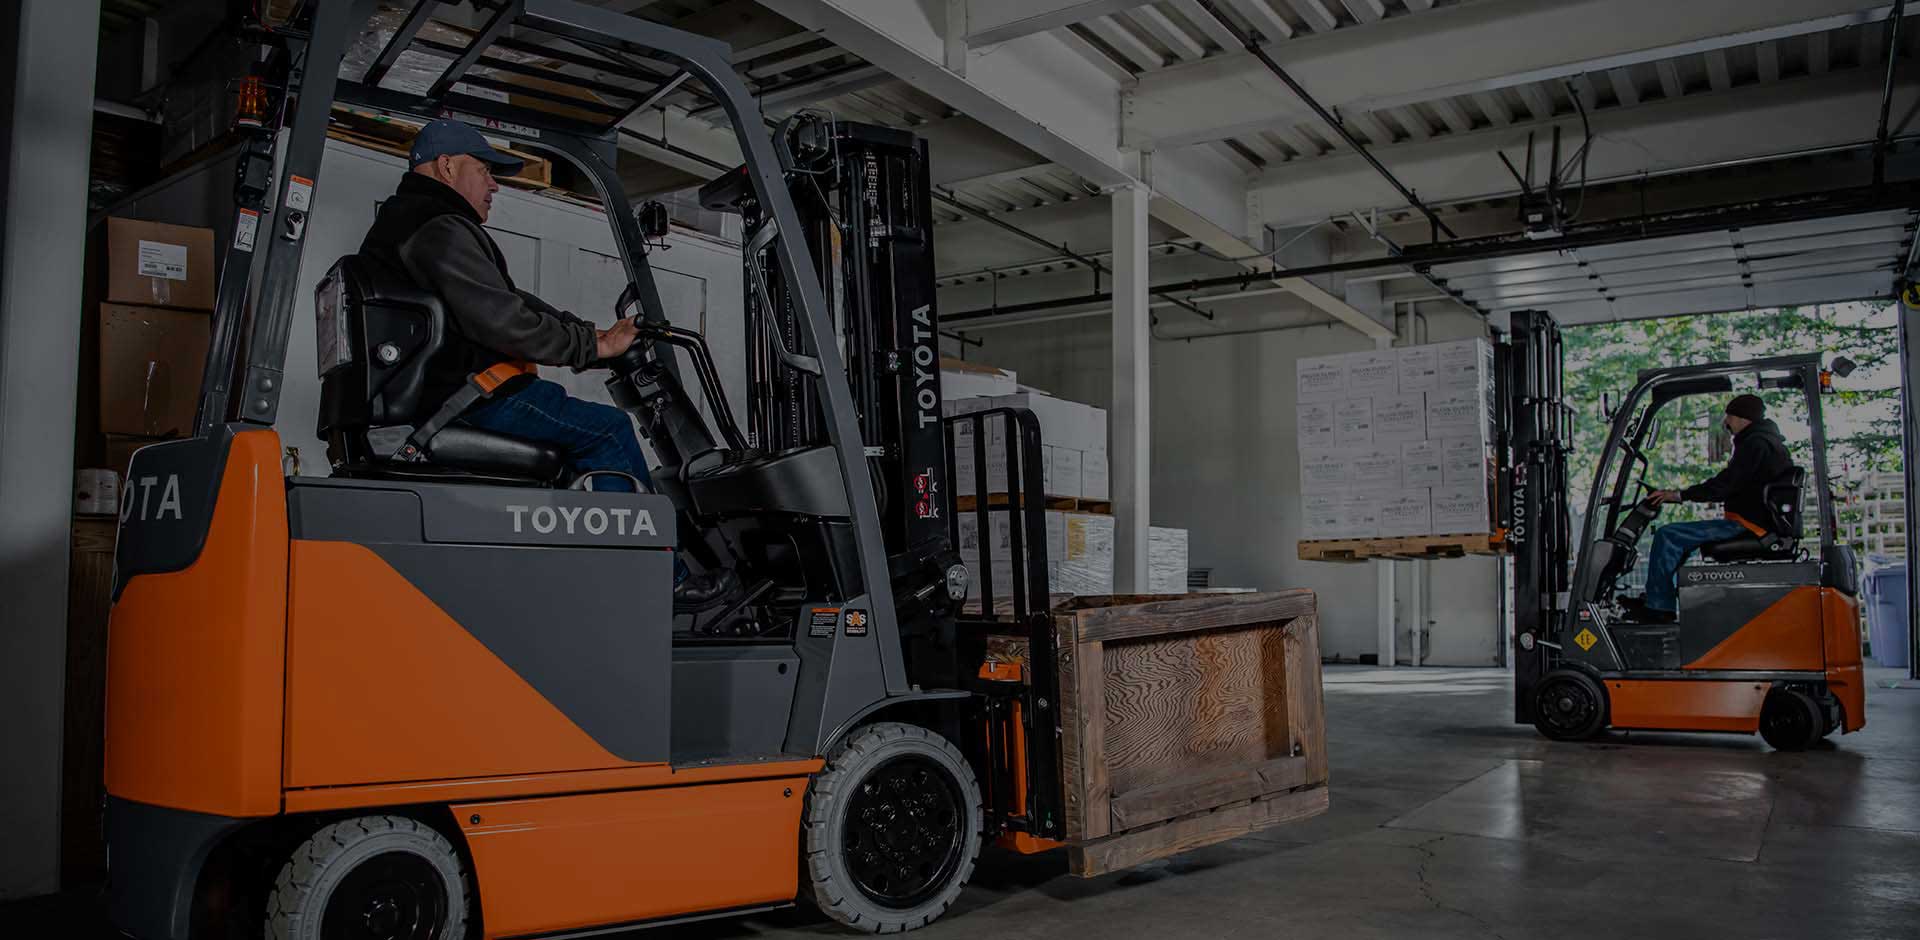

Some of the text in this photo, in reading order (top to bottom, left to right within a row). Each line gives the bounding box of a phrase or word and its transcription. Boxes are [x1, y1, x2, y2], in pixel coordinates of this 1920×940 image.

[911, 303, 937, 429] TOYOTA
[505, 504, 657, 537] TOYOTA
[1513, 488, 1525, 545] TOYOTA
[1703, 570, 1744, 580] TOYOTA
[845, 611, 867, 625] SAS
